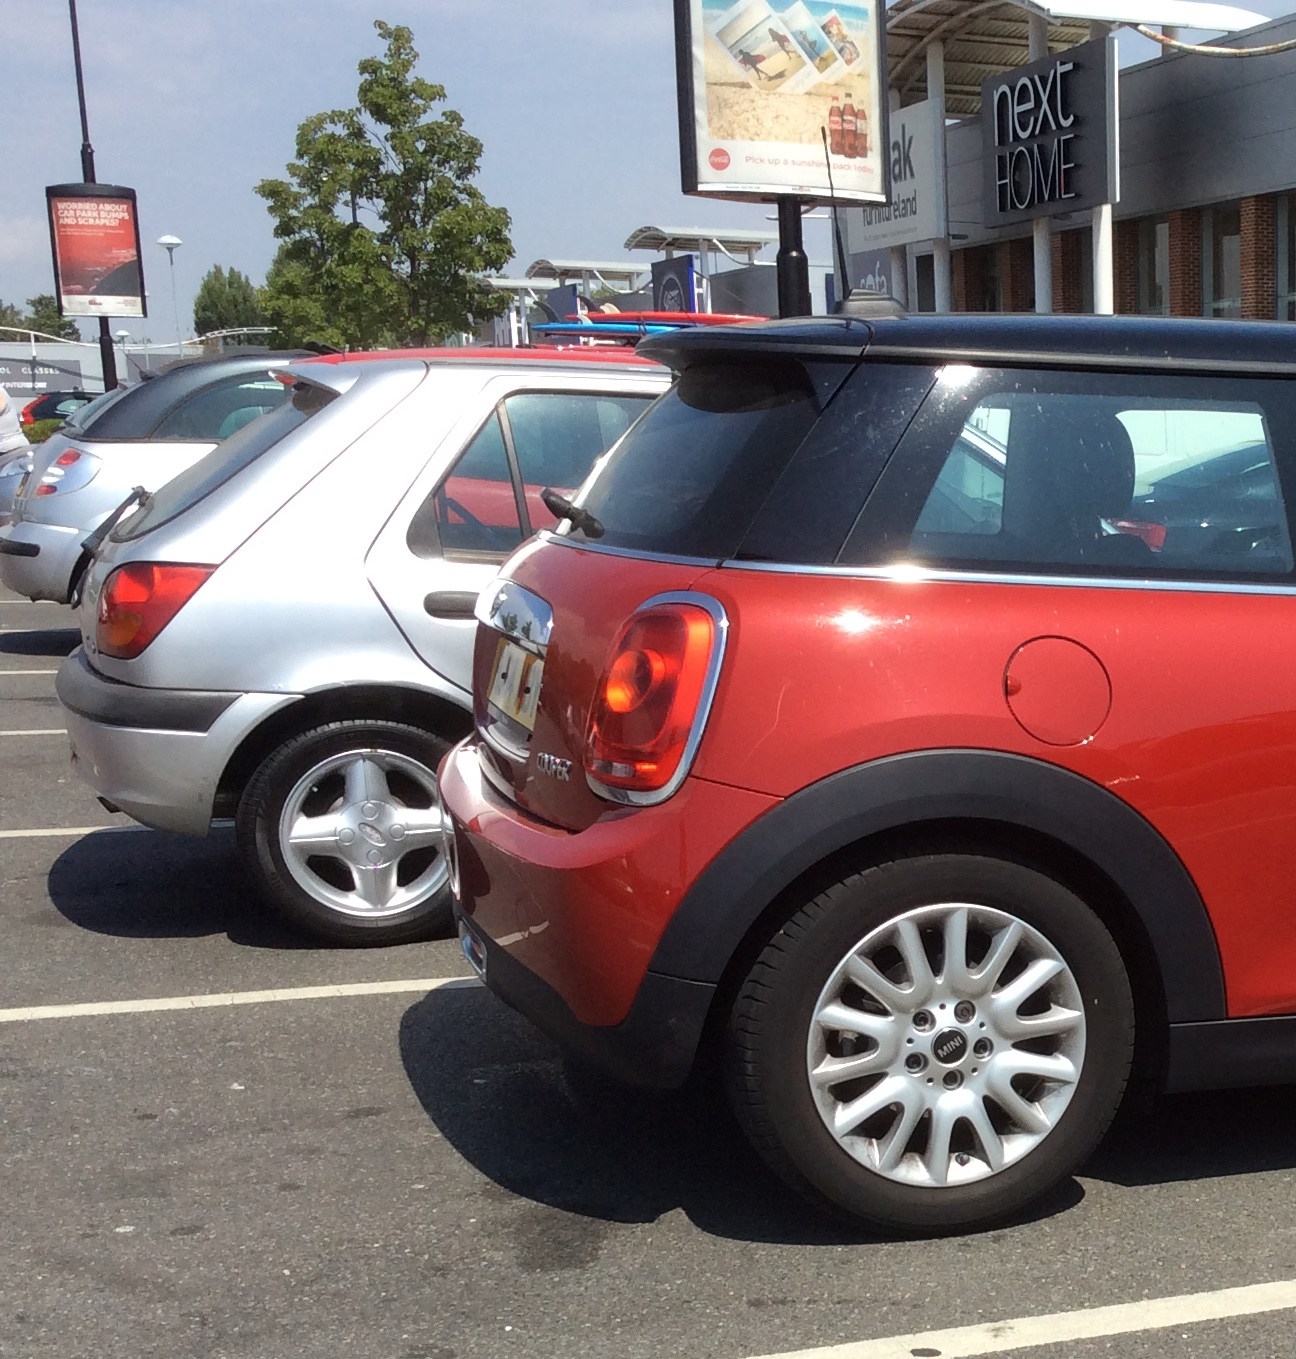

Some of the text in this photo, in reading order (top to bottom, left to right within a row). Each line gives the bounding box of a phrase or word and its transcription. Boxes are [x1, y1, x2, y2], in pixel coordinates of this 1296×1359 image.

[993, 60, 1075, 147] next
[745, 155, 764, 164] Pick
[768, 158, 780, 166] up
[832, 162, 854, 171] pack
[995, 133, 1076, 213] HOME
[57, 202, 127, 212] WORRIED ABOUT
[58, 209, 129, 219] CAR PARK BUMPS
[59, 217, 77, 225] AND
[937, 1036, 963, 1058] MINI
